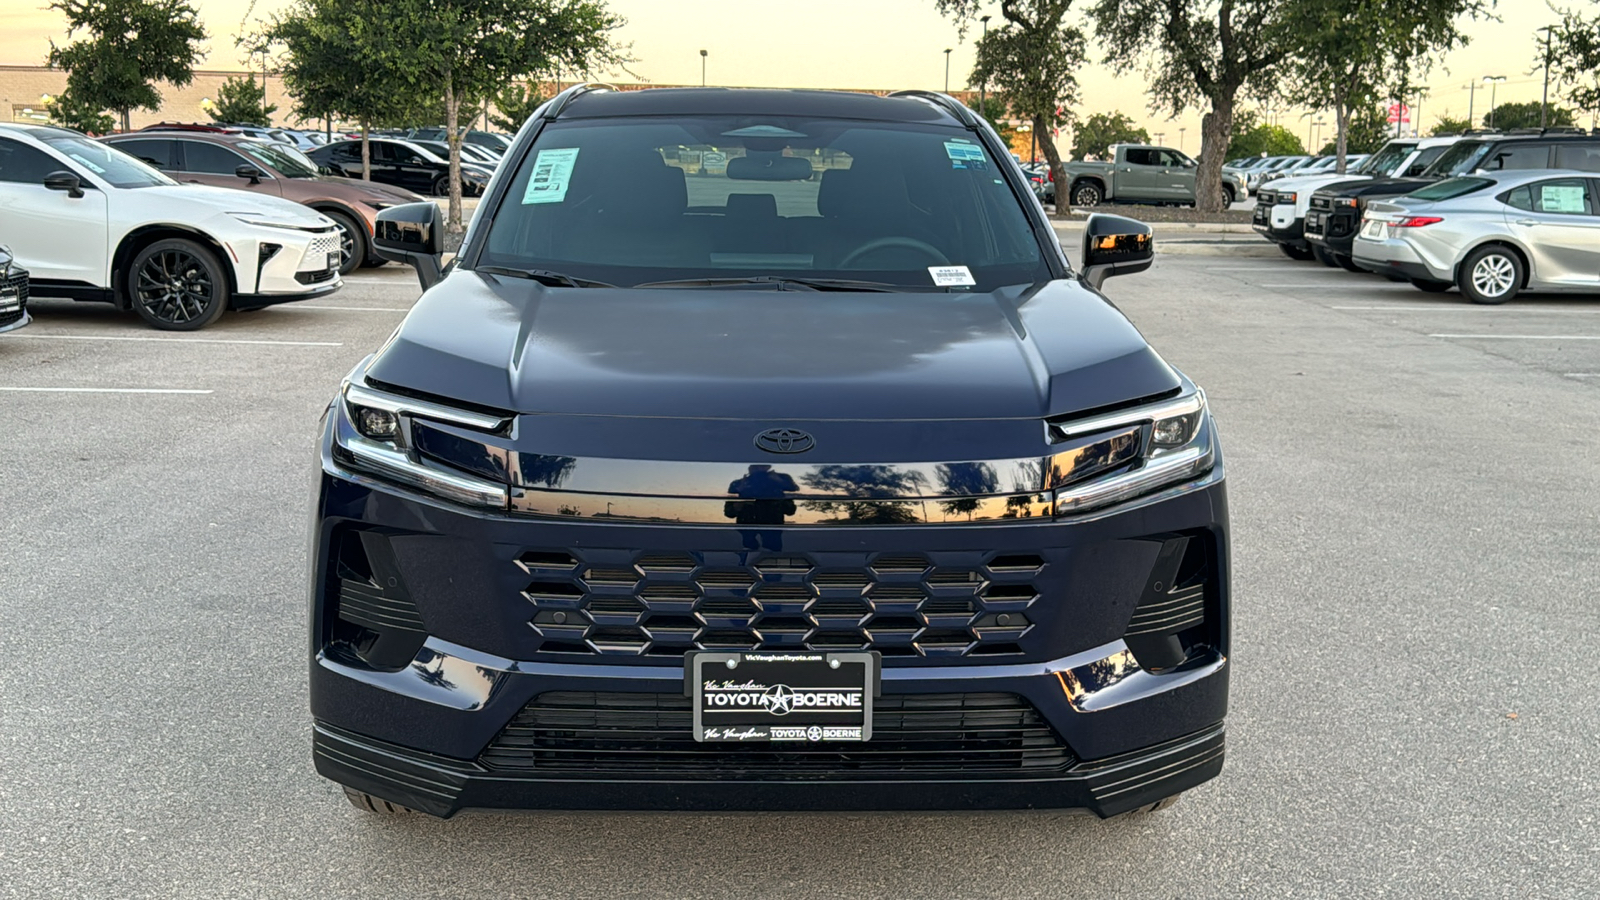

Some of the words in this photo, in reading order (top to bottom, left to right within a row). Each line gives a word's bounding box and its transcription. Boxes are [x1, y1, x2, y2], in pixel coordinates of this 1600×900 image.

[745, 654, 822, 662] VicVaughanToyota.com
[704, 693, 770, 706] TOYOTA
[793, 693, 862, 706] BOERNE
